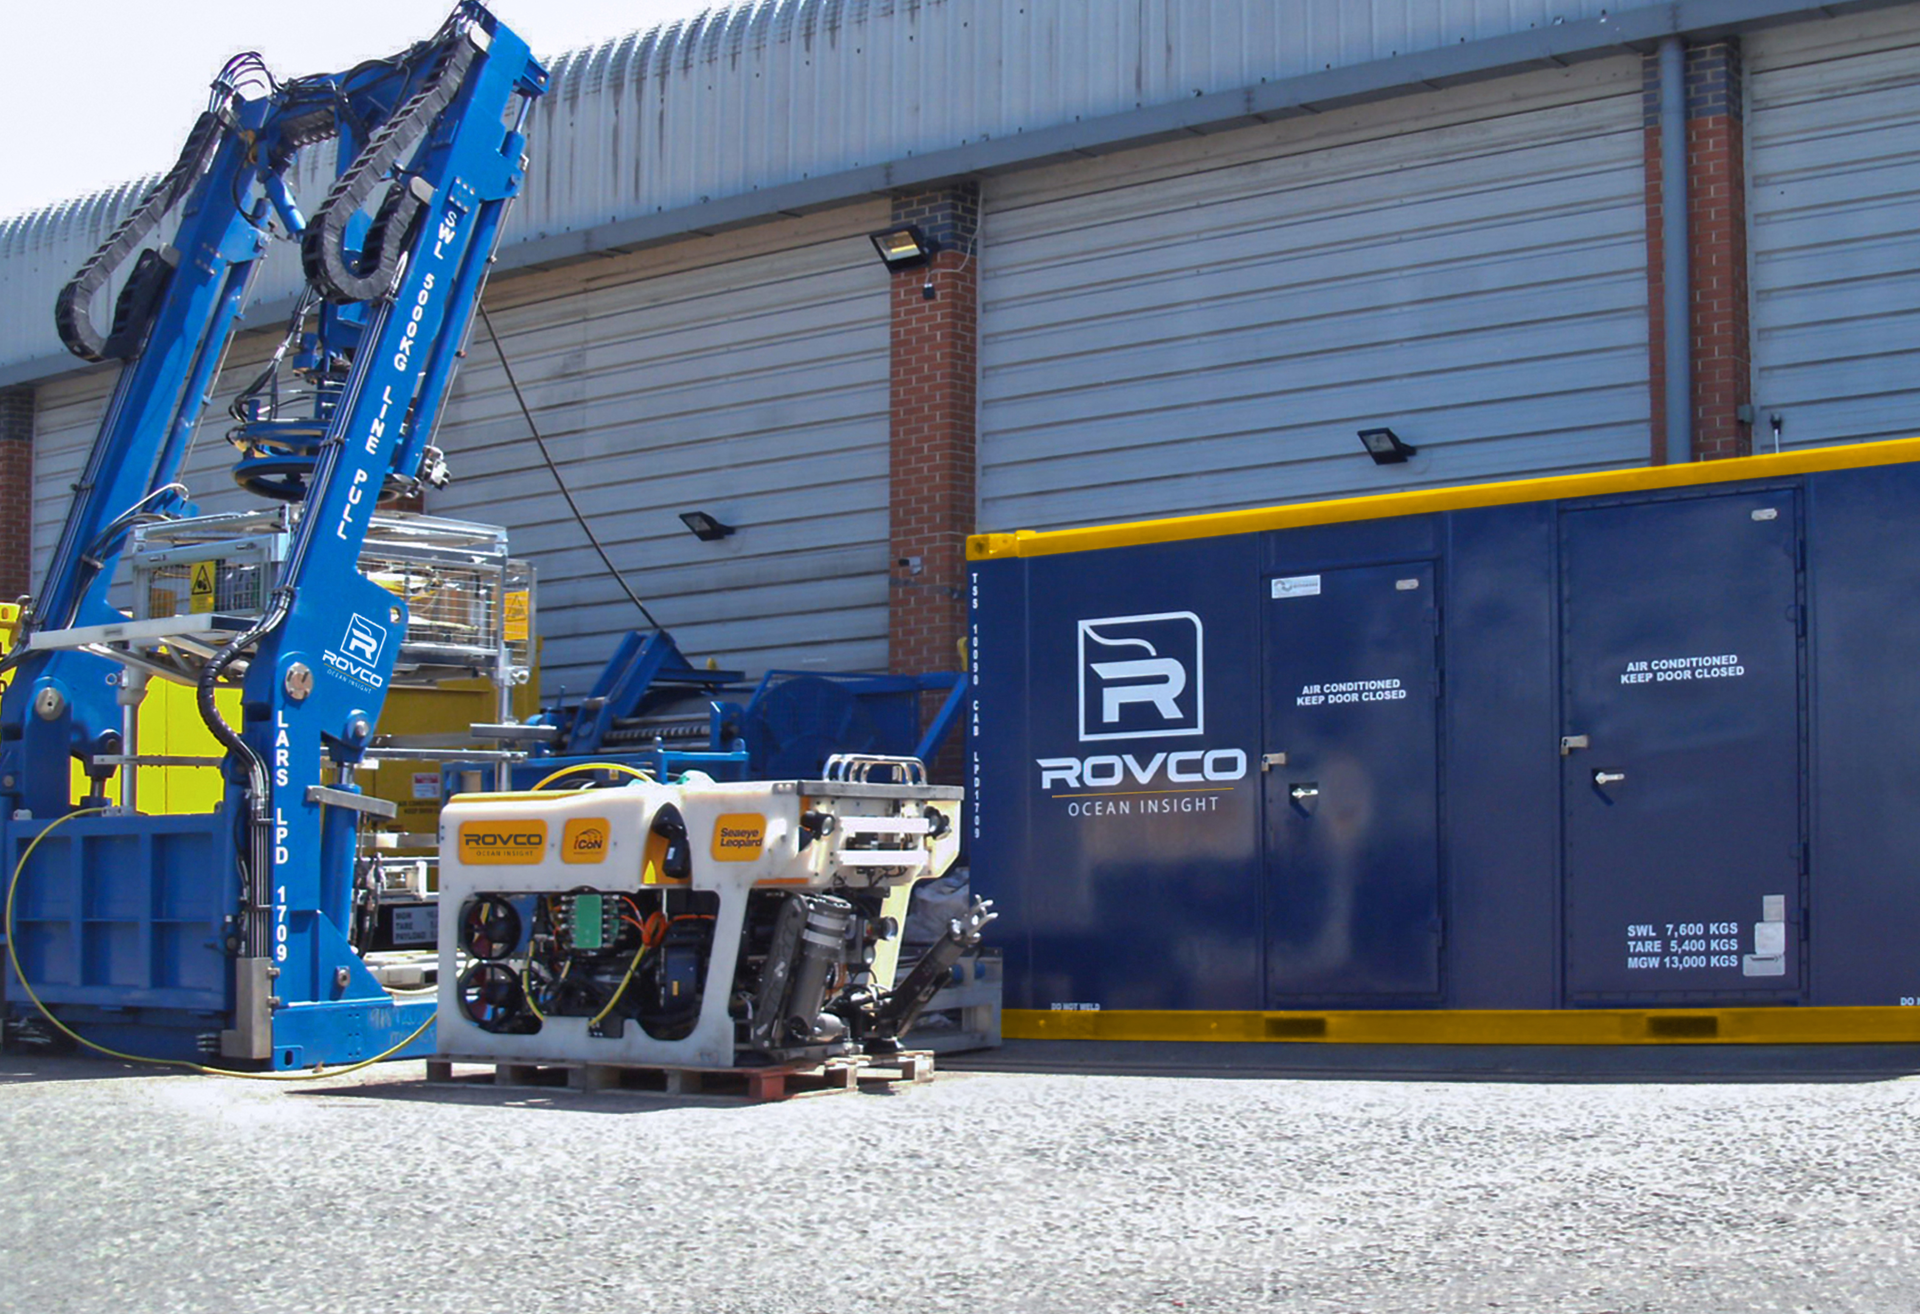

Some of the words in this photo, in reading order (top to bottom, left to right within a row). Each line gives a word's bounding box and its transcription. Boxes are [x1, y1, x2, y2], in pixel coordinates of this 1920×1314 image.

[434, 210, 457, 260] SWL
[394, 272, 435, 371] 5000KG
[365, 385, 393, 455] LINE
[337, 468, 368, 540] PULL
[971, 572, 979, 609] TSS
[322, 649, 383, 687] ROVCO
[1626, 661, 1649, 673] AIR
[1651, 654, 1738, 670] CONDITIONED
[326, 668, 347, 683] OCEAN
[1620, 672, 1654, 684] KEEP
[1656, 669, 1693, 682] DOOR
[1694, 665, 1745, 679] CLOSED
[1302, 685, 1322, 695] AIR
[1323, 679, 1401, 693] CONDITIONED
[1296, 695, 1325, 706] KEEP
[1327, 692, 1360, 704] DOOR
[1361, 689, 1407, 701] CLOSED
[972, 699, 980, 736] CAB
[275, 710, 290, 787] LARS
[1036, 748, 1247, 789] ROVCO
[1068, 800, 1131, 817] OCEAN
[1140, 796, 1219, 814] INSIGHT
[275, 808, 289, 865] LPD
[464, 834, 543, 846] ROVCO
[721, 827, 760, 839] Seaeye
[721, 838, 763, 849] Leopard
[276, 885, 288, 962] 1709
[1627, 924, 1657, 937] SWL
[1665, 923, 1704, 938] 7,600
[1709, 922, 1738, 935] KGS
[1627, 940, 1662, 953] TARE
[1669, 939, 1706, 954] 5,400
[1710, 938, 1738, 951] KGS
[1627, 956, 1660, 969] MGW
[1663, 955, 1706, 971] 13,000
[1710, 954, 1738, 967] KGS
[1900, 996, 1915, 1006] DO
